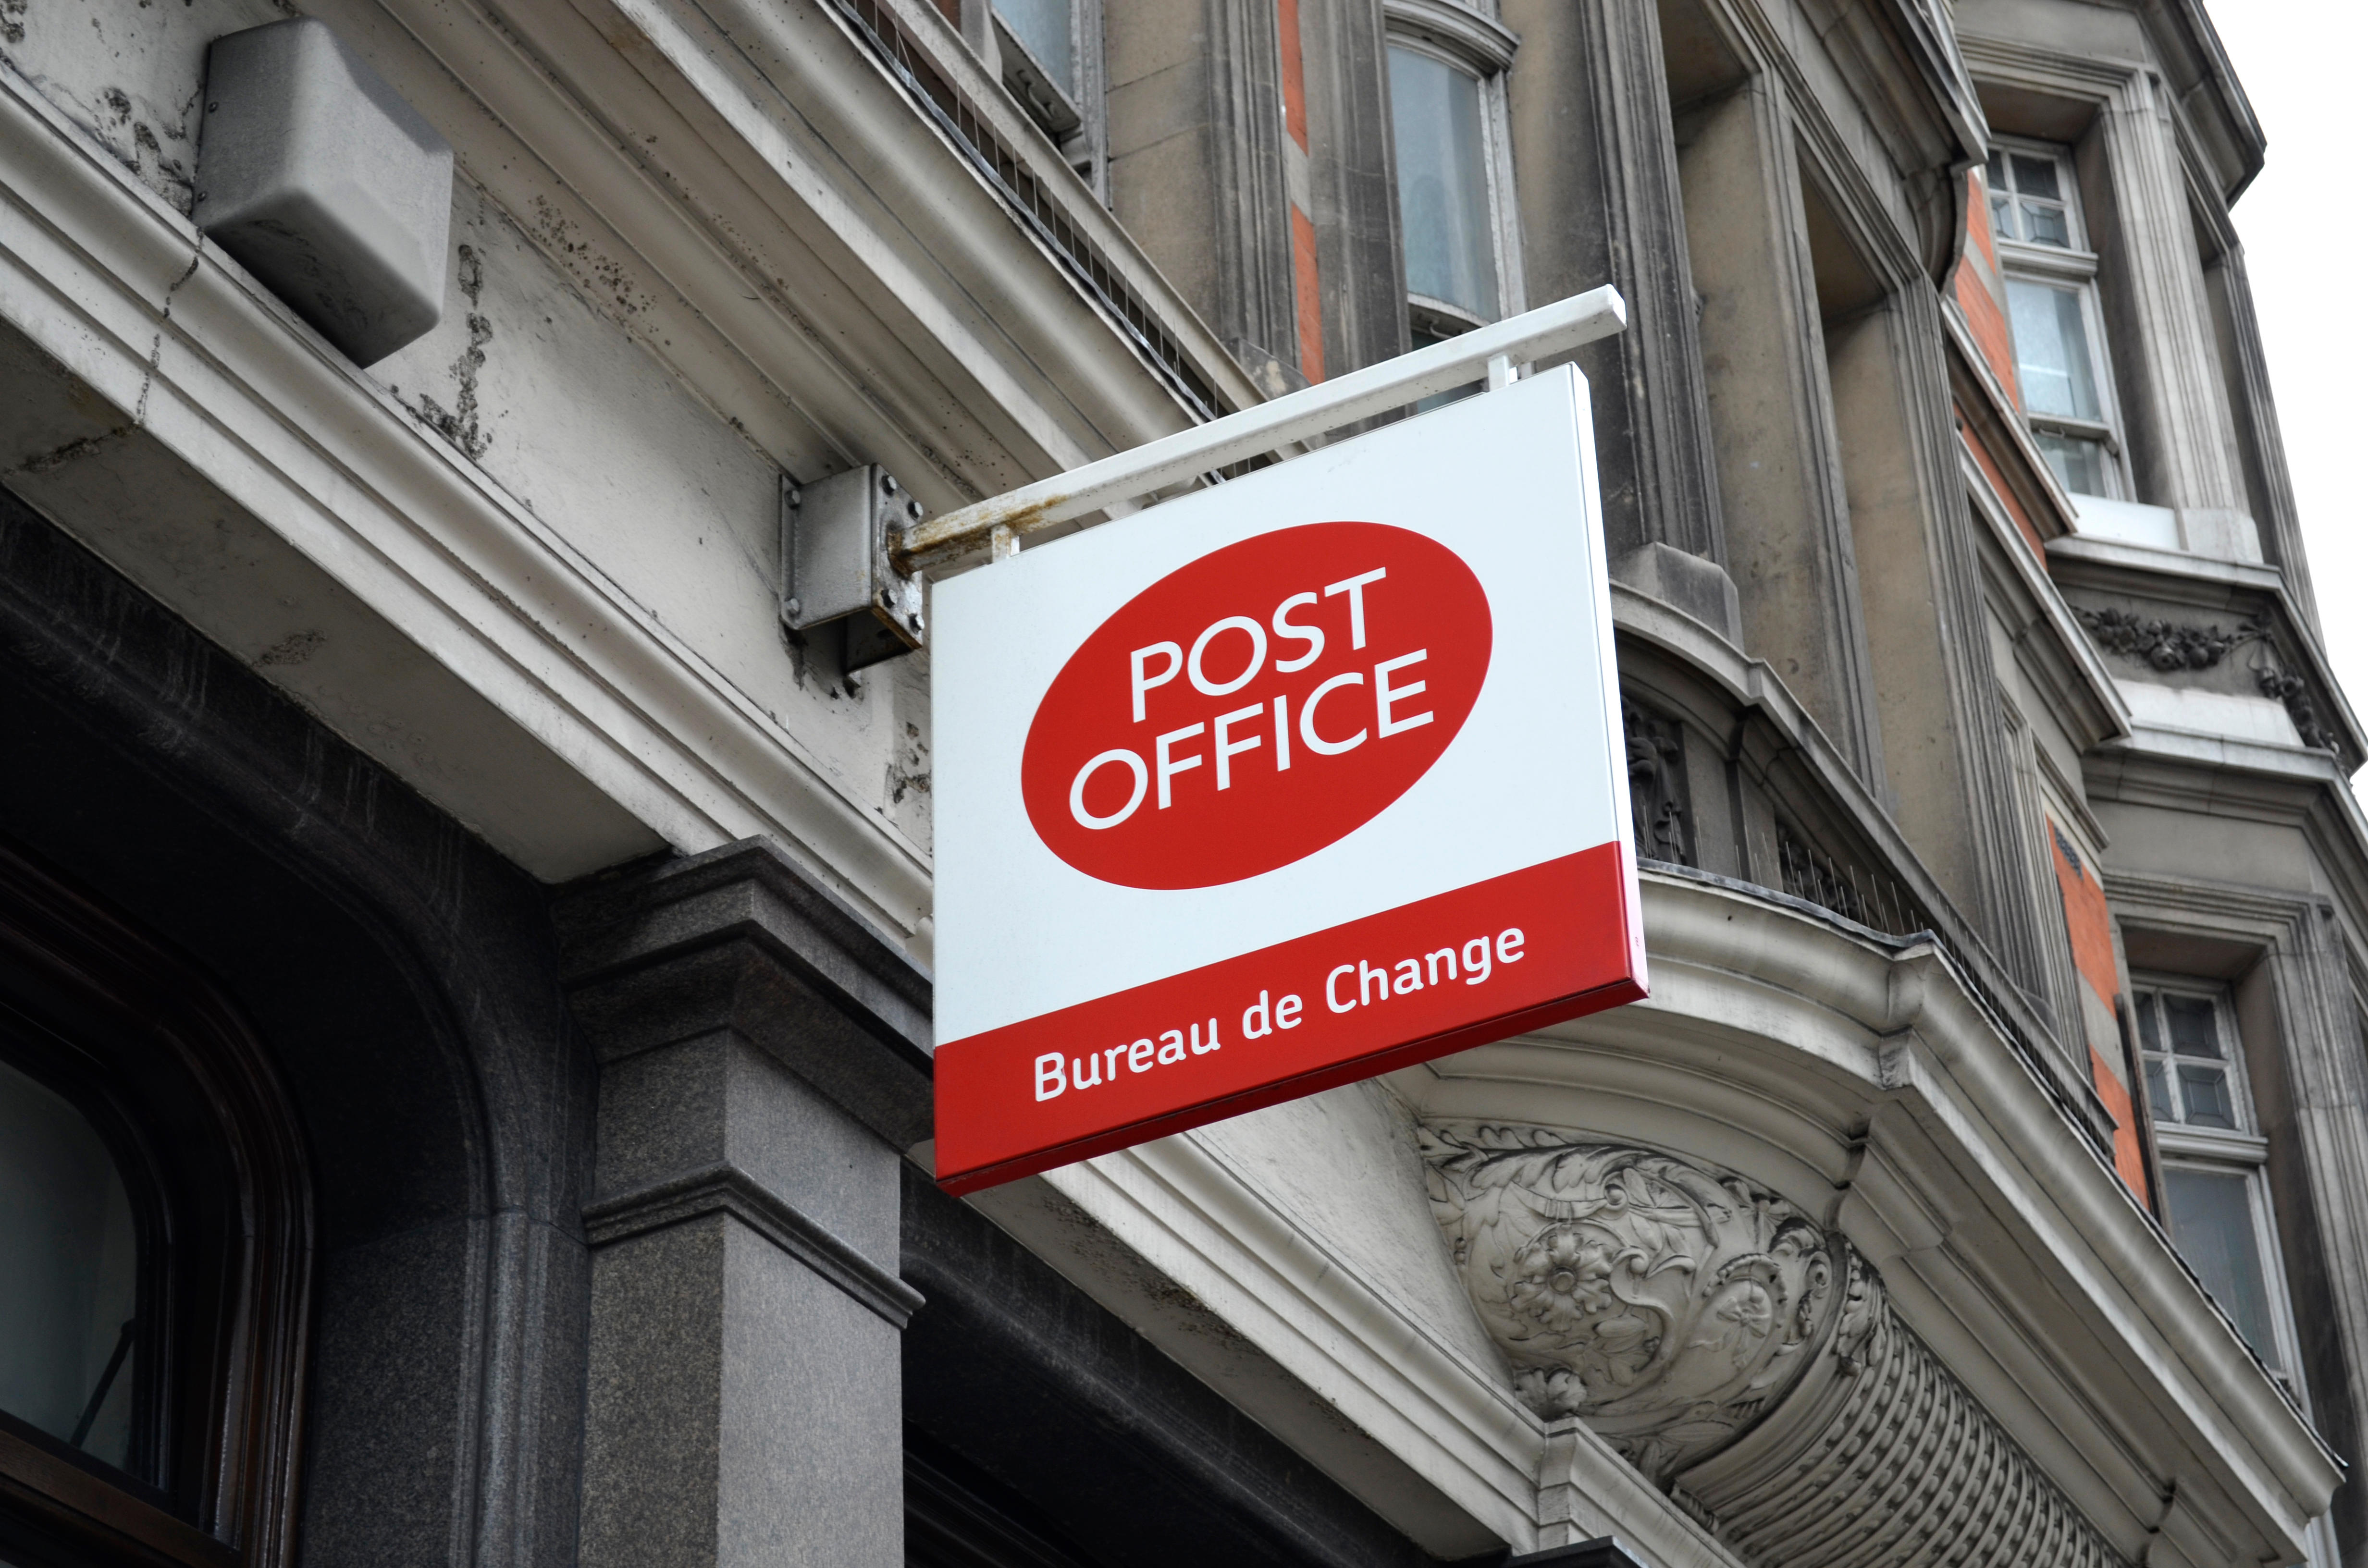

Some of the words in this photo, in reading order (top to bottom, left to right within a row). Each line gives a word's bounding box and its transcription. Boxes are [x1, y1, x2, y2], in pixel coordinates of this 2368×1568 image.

[1130, 566, 1386, 723] POST
[1069, 648, 1434, 830] OFFICE
[1035, 1017, 1221, 1102] Bureau
[1242, 990, 1303, 1040] de
[1326, 928, 1525, 1014] Change
